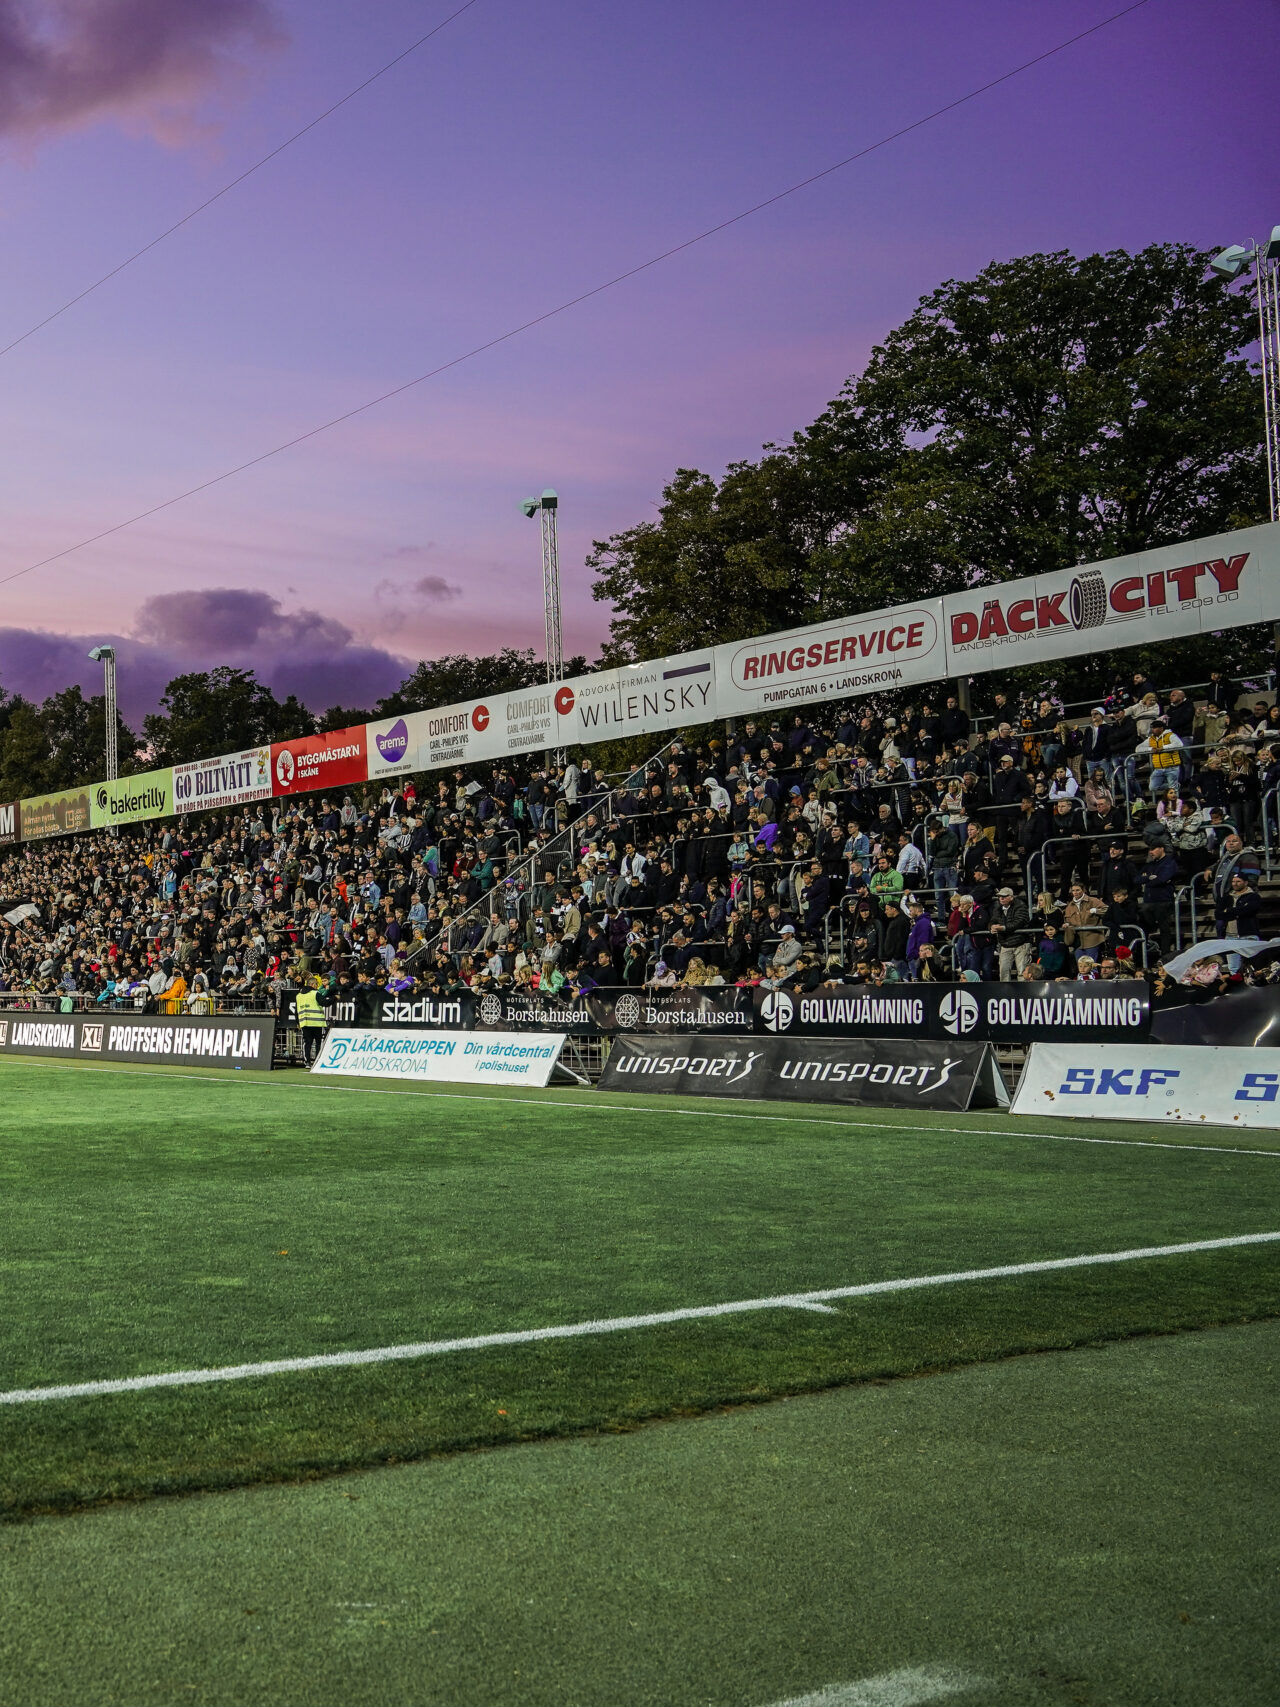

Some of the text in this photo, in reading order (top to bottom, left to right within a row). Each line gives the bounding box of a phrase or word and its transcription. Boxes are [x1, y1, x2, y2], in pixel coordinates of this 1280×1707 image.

[1109, 552, 1250, 613] CITY
[951, 592, 1070, 645] DÄCK
[1147, 606, 1177, 617] TEL.
[1181, 597, 1213, 611] 209
[743, 622, 925, 680] RINGSERVICE
[953, 632, 1036, 653] LANDSKRONA
[579, 674, 657, 698] ADVOKATFIRMAN
[764, 668, 903, 703] PUMPGATAN 6 LANDSKRONA
[506, 696, 551, 721] COMFORT
[580, 681, 711, 728] WILENSKY
[429, 713, 469, 736] COMFORT
[459, 734, 469, 744] VVS
[297, 744, 360, 767] BYGGMÄSTAR'N
[176, 761, 252, 800] GO BILTVÄTT
[300, 767, 319, 778] SKÅNE
[110, 787, 166, 815] bakertilly
[176, 804, 182, 813] NU
[184, 800, 196, 811] BÅDE
[197, 798, 203, 809] PÅ
[233, 795, 237, 803] &
[238, 788, 272, 802] PUMPGATAN!
[382, 998, 461, 1023] stadium
[507, 1006, 589, 1023] Borstahusen
[646, 1007, 746, 1025] Borstahusen
[800, 995, 923, 1024] GOLVAVJÄMNING
[987, 993, 1141, 1025] GOLVAVJÄMNING
[11, 1022, 75, 1048] LANDSKRONA
[82, 1027, 101, 1048] XL
[108, 1026, 173, 1054] PROFFSENS
[173, 1028, 261, 1058] HEMMAPLAN
[351, 1034, 556, 1059] LÄKARGRUPPEN Din vårdcentral
[343, 1056, 530, 1074] LANDSKRONA i polishuset
[615, 1056, 742, 1077] UNISPORT
[779, 1060, 936, 1086] UNISPORT
[1059, 1068, 1181, 1095] SKF
